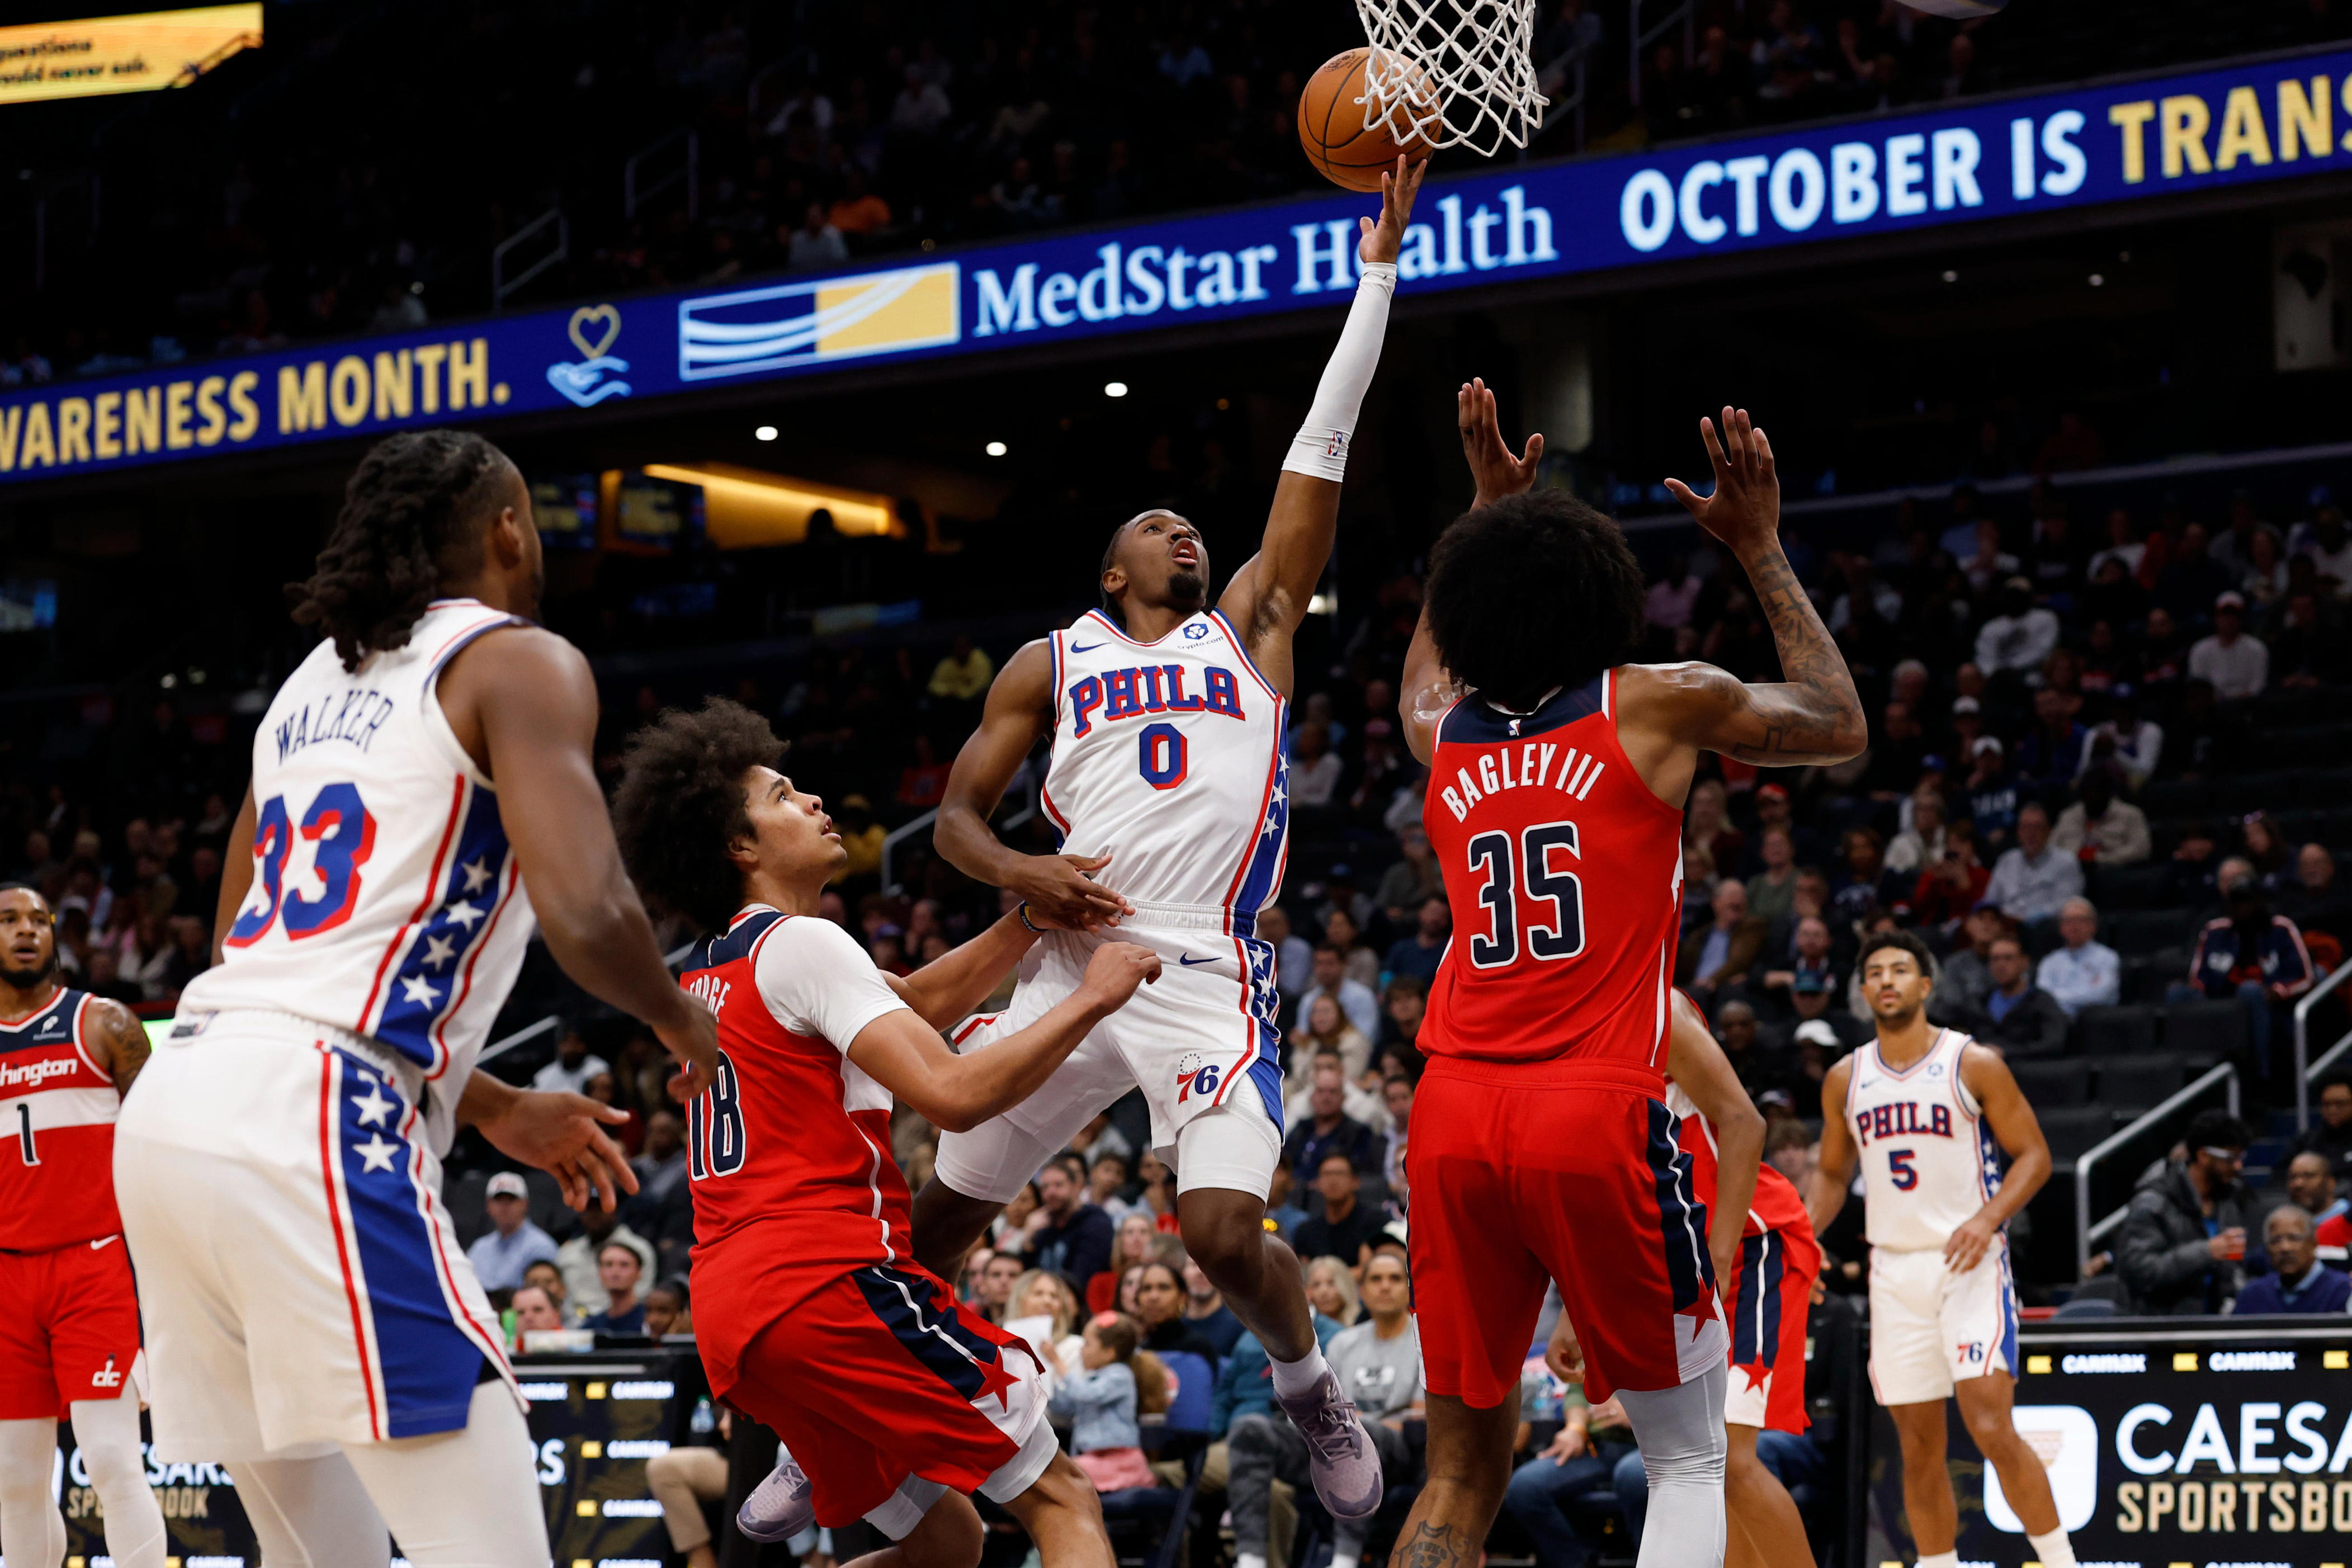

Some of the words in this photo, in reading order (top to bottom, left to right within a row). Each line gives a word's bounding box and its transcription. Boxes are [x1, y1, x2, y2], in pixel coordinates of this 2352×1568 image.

[1619, 127, 1984, 253] OCTOBER
[2010, 109, 2087, 201] IS
[2108, 72, 2352, 185] TRAN
[972, 241, 1278, 338] MedStar
[1290, 184, 1560, 295] Halth
[278, 337, 512, 434] MONTH.
[1177, 636, 1224, 650] crypto.com
[275, 689, 393, 764] WALKER
[1069, 664, 1246, 739] PHILA
[1139, 723, 1187, 790] 0
[1441, 743, 1557, 823] BAGLEY
[1555, 747, 1605, 801] III
[225, 782, 377, 948] 33
[1467, 820, 1585, 970] 35
[0, 1058, 78, 1087] hington
[1177, 1065, 1220, 1106] 76
[17, 1103, 41, 1166] 1
[686, 1047, 746, 1181] 18
[1856, 1101, 1954, 1147] PHILA
[1888, 1150, 1919, 1192] 5
[1957, 1343, 1983, 1364] 76
